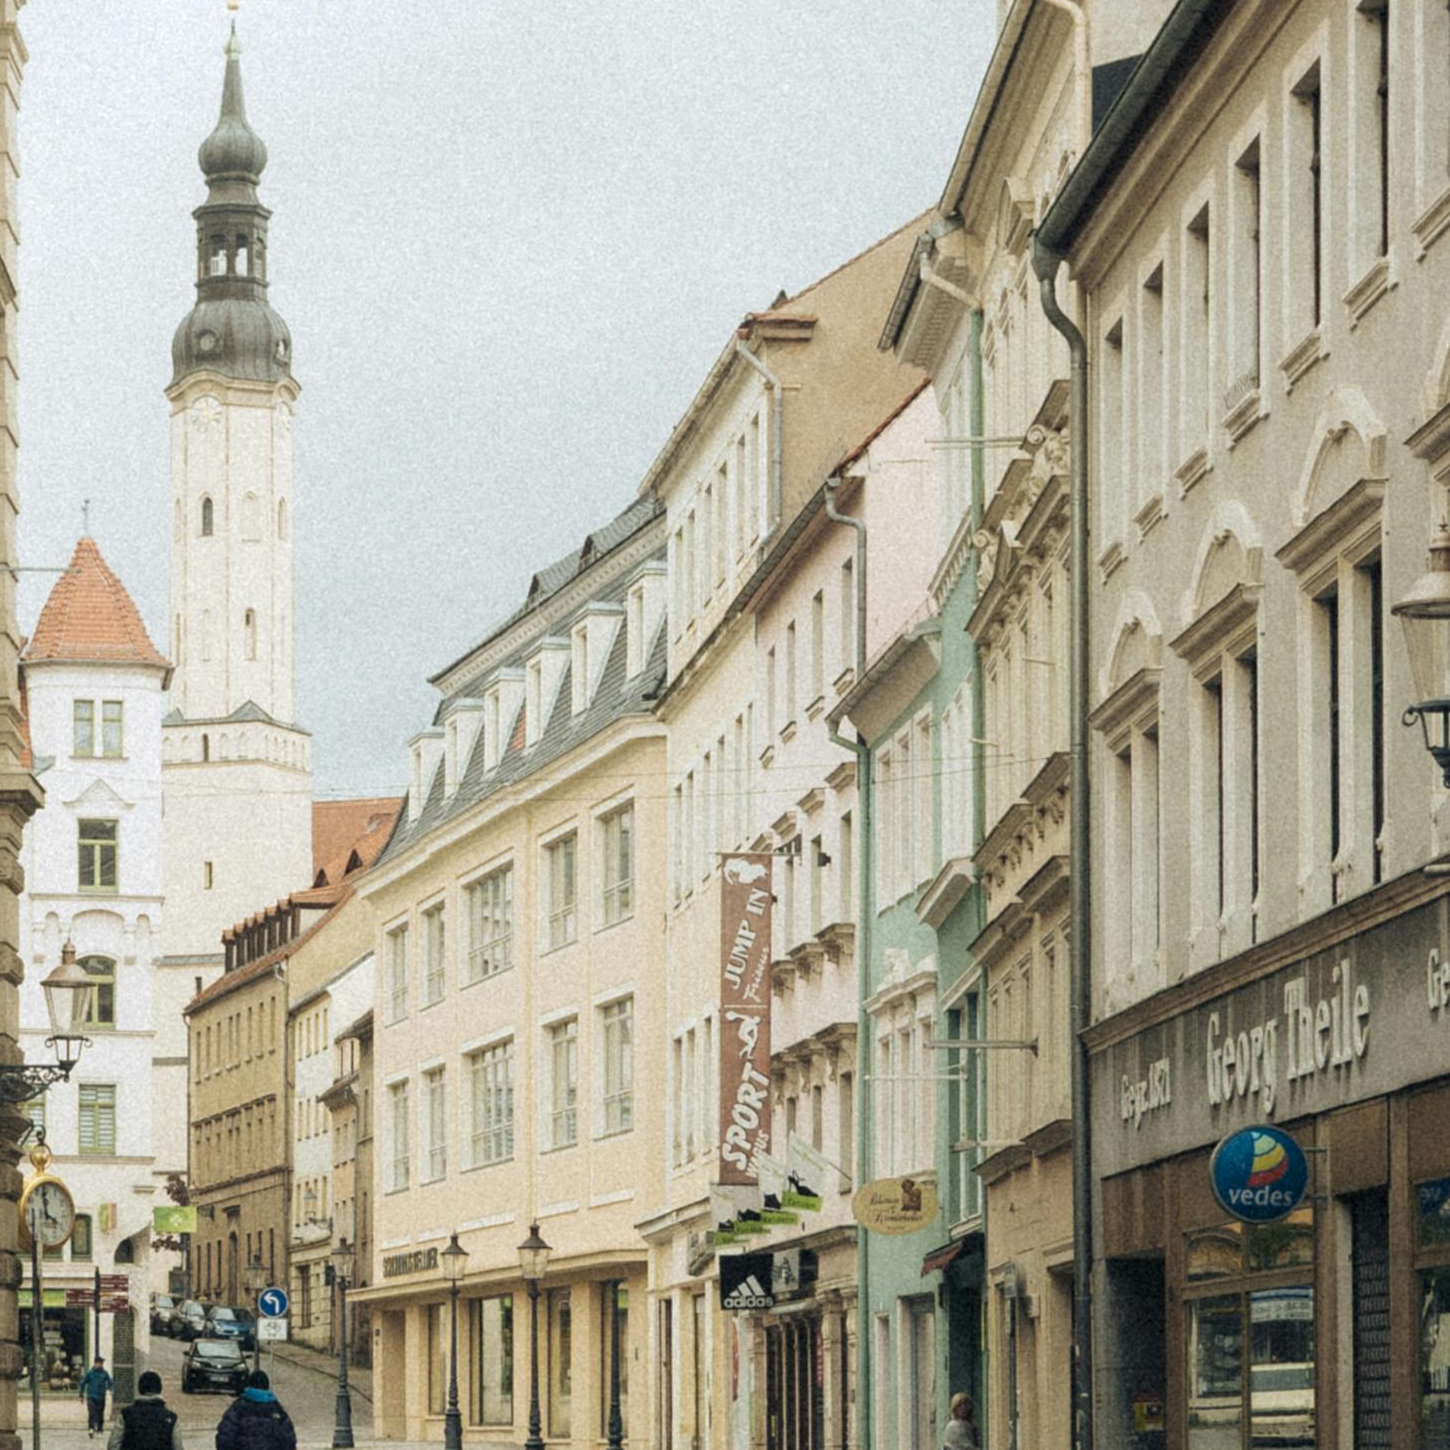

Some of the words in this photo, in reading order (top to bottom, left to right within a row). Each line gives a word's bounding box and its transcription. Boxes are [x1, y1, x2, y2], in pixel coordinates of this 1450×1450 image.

[724, 919, 757, 990] JUMP
[746, 885, 769, 916] IN
[1207, 1011, 1278, 1114] Georg
[1284, 958, 1370, 1080] Theile
[722, 1061, 770, 1171] SPORT
[1228, 1185, 1293, 1207] vedes
[723, 1296, 774, 1308] adidas
